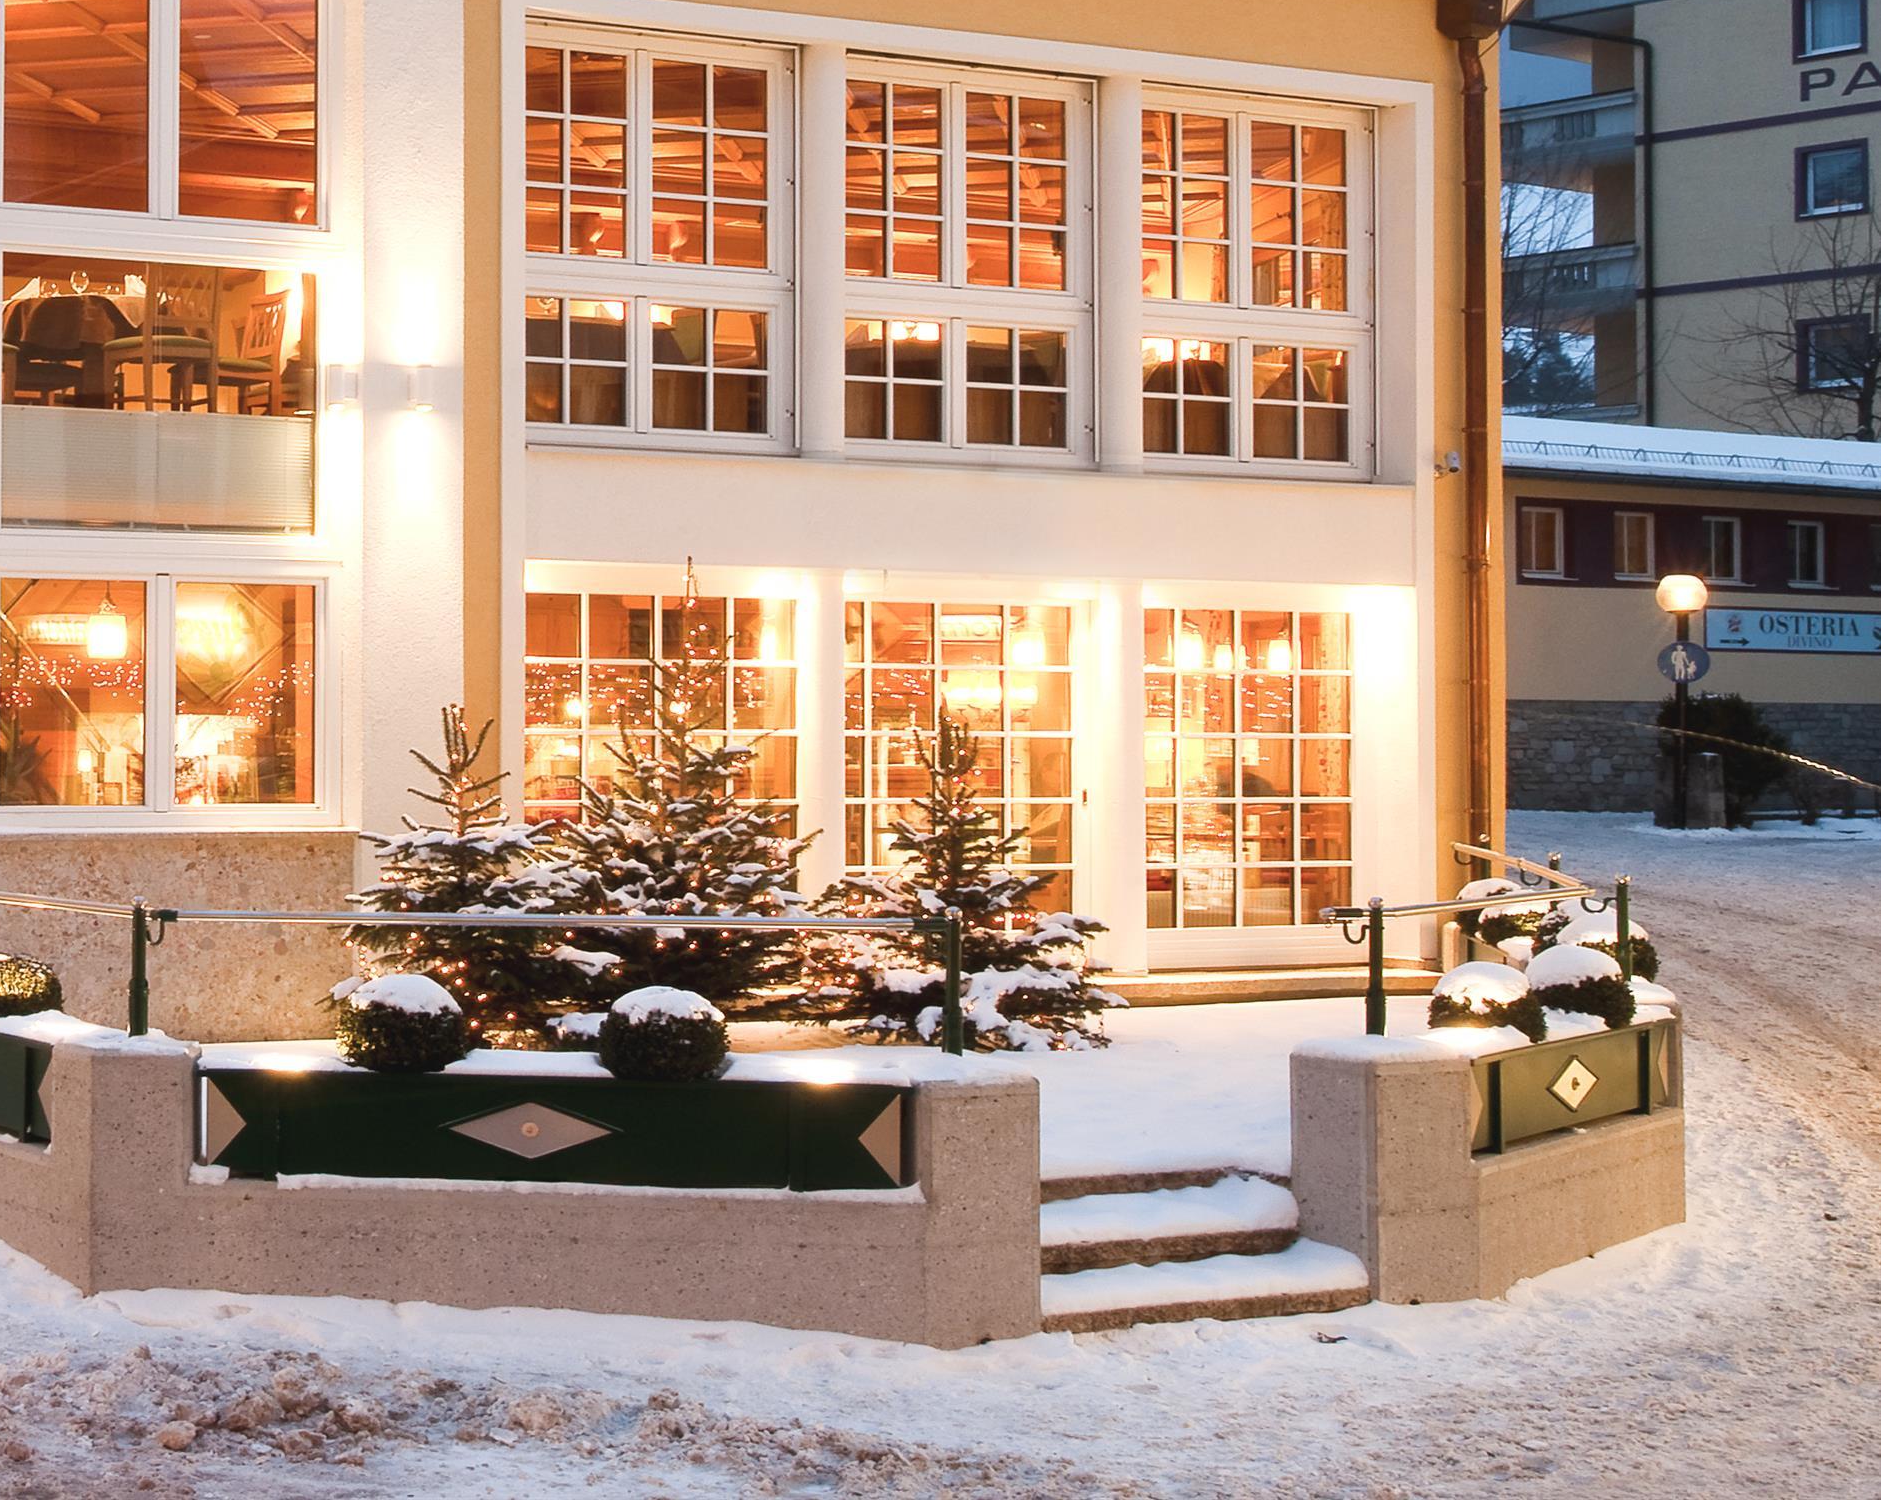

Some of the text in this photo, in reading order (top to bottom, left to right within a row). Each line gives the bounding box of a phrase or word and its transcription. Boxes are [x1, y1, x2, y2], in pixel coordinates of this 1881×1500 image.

[1800, 61, 1881, 102] PA
[1759, 614, 1860, 636] OSTERIA
[1787, 636, 1833, 648] DIVINO
